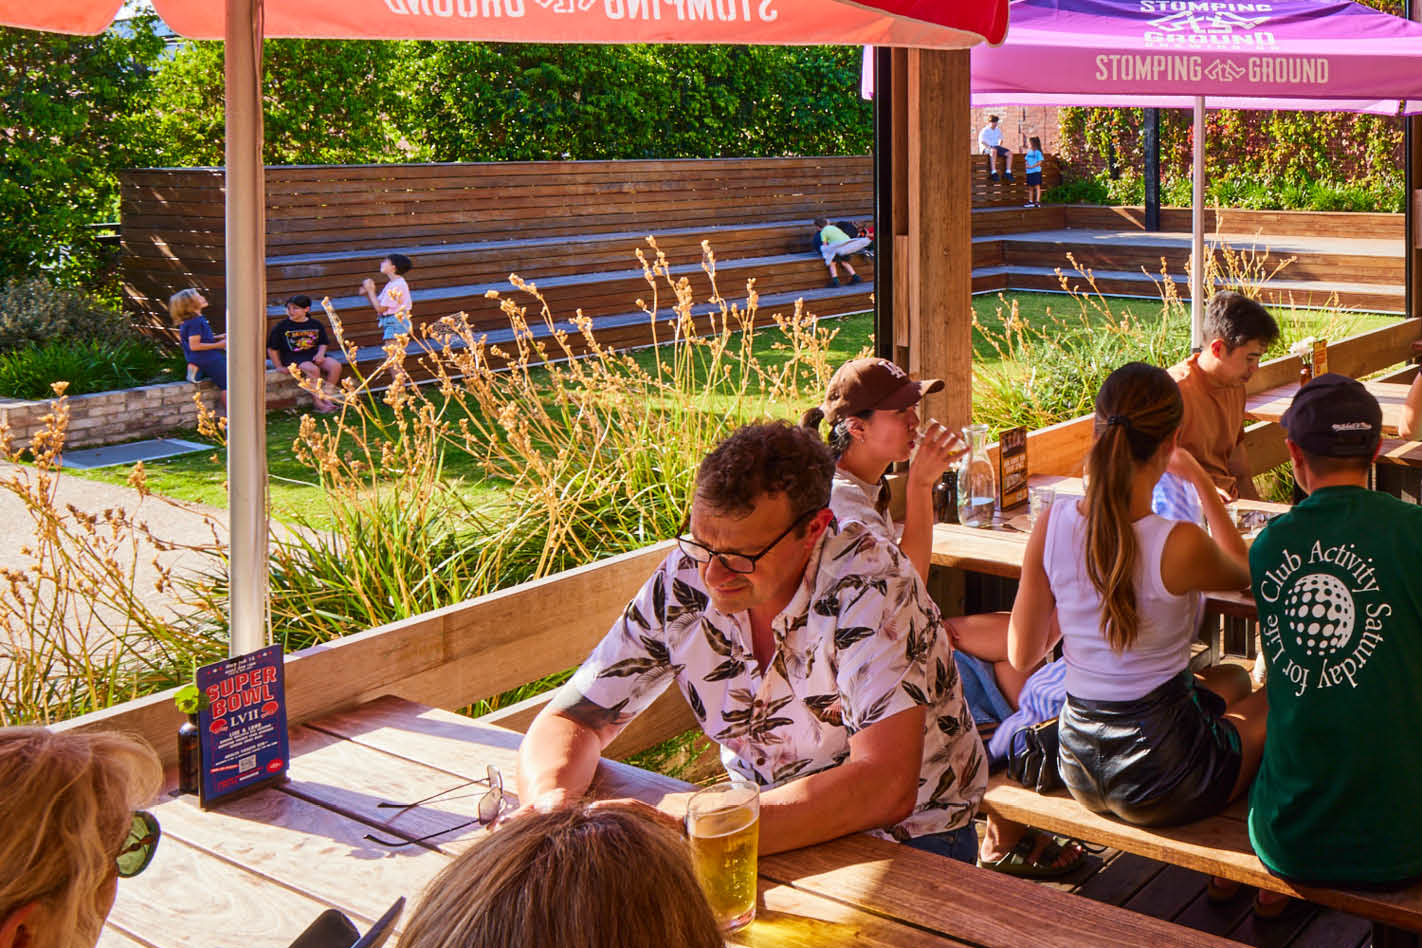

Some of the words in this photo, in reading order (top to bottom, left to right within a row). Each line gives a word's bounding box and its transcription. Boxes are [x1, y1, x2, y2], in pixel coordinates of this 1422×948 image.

[1140, 0, 1273, 12] STOMPING
[1144, 31, 1275, 45] GROUND
[1095, 55, 1202, 81] STOMPING
[1249, 57, 1329, 84] GROUND
[1261, 549, 1302, 603] Club
[1308, 539, 1380, 593] Activity
[1264, 614, 1285, 664] Life
[1318, 602, 1392, 689] Saturday
[206, 665, 277, 703] SUPER
[1282, 659, 1310, 697] for
[212, 684, 274, 720] BOWL
[230, 709, 259, 727] LVII
